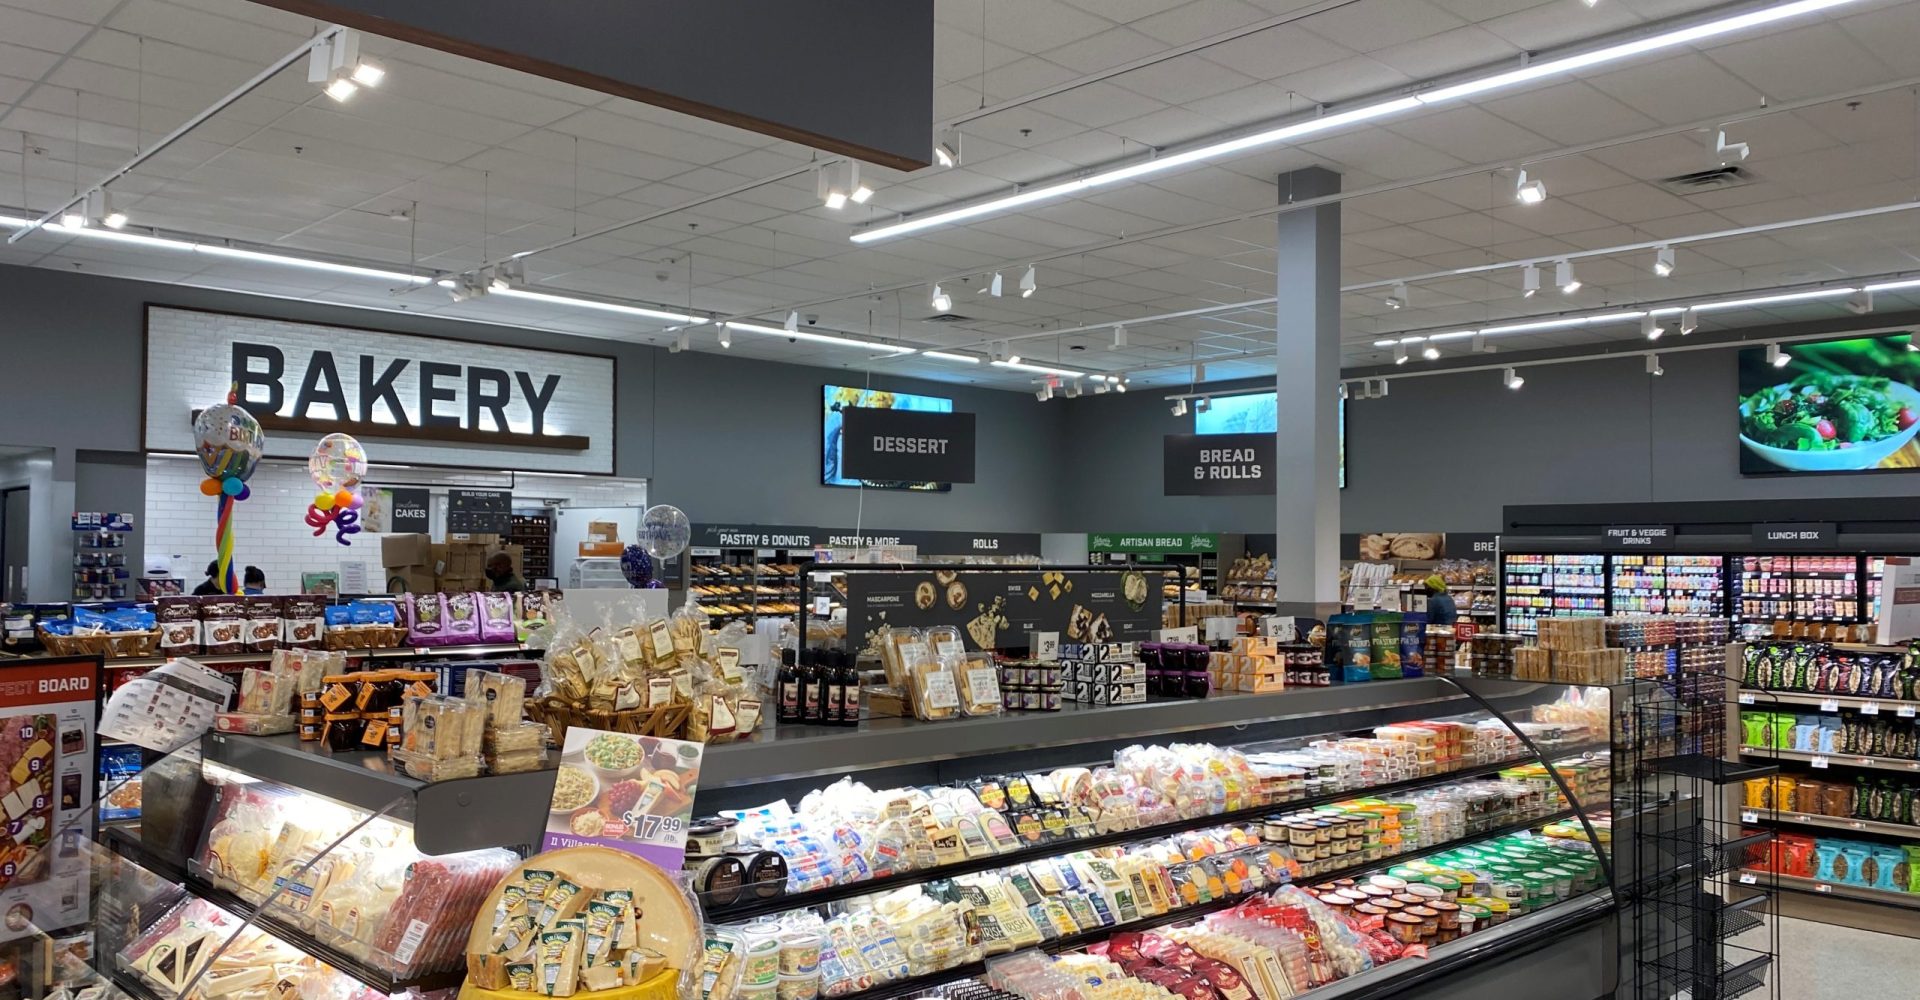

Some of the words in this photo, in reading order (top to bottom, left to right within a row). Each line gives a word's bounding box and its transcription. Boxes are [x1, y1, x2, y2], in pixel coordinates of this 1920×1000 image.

[232, 342, 561, 435] BAKERY
[873, 436, 949, 454] DESSERT
[1200, 448, 1255, 463] BREAD
[1194, 466, 1205, 479] &
[1209, 465, 1262, 479] ROLLS
[395, 508, 426, 518] CAKES
[719, 533, 759, 545] PASTRY
[762, 534, 769, 545] &
[772, 534, 810, 546] DONUTS
[1767, 531, 1798, 539] LUNCH
[1799, 531, 1819, 539] BOX
[829, 535, 865, 546] PASTRY
[866, 536, 873, 546] &
[874, 537, 900, 547] MORE
[973, 538, 998, 549] ROLLS
[1119, 538, 1153, 547] ARTISAN
[1155, 538, 1183, 547] BREAD
[1622, 537, 1652, 545] DRINKS
[1473, 542, 1496, 552] BRE
[38, 676, 89, 693] BOARD
[21, 727, 33, 738] 10
[31, 760, 40, 771] 9
[36, 797, 44, 808] 8
[11, 822, 20, 832] 7
[551, 837, 558, 846] Il
[561, 838, 604, 847] Villai
[4, 865, 13, 875] 6
[1003, 918, 1028, 933] IRISH
